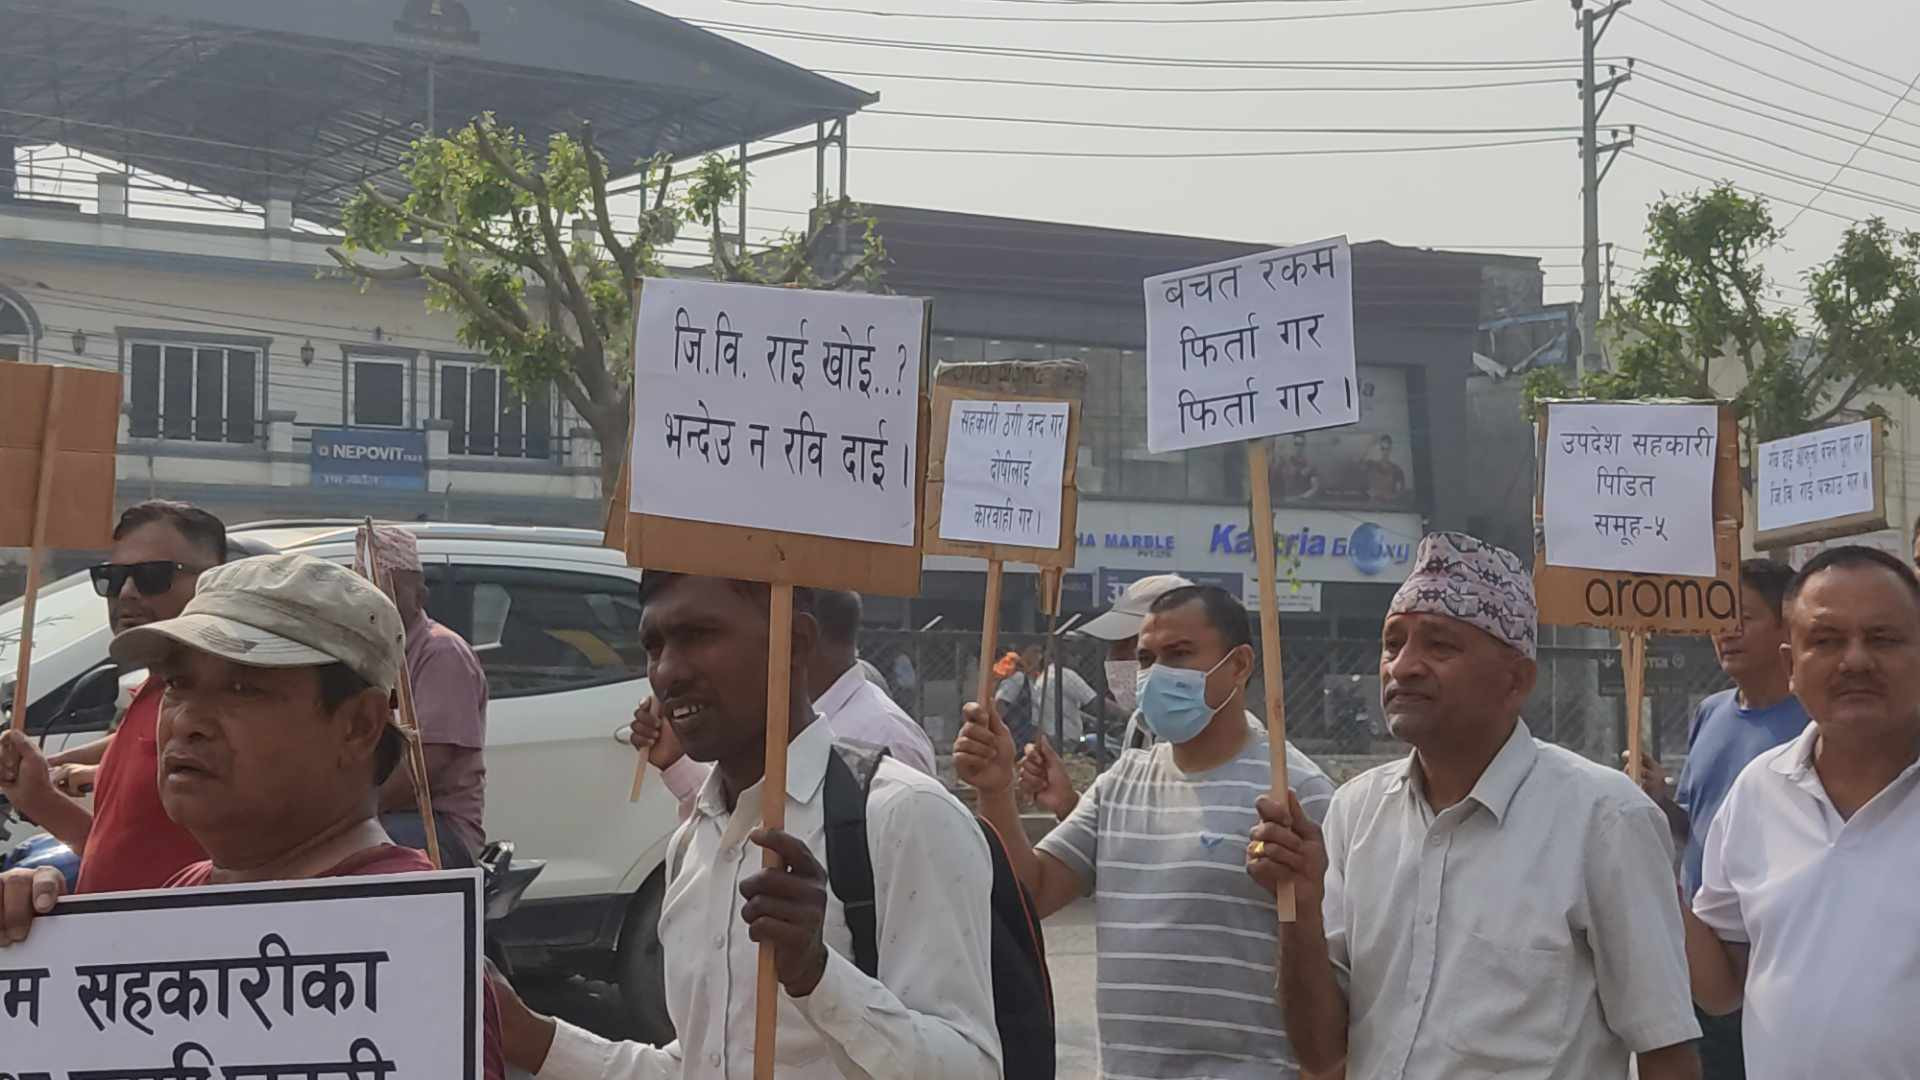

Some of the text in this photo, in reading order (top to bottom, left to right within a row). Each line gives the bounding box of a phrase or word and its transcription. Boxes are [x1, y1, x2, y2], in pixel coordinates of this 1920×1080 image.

[1161, 245, 1338, 309] बचत रकम
[766, 318, 808, 391] राई
[1180, 312, 1324, 371] फिर्ता गर
[961, 403, 1000, 437] सहकारी
[1050, 414, 1065, 438] गर
[1178, 377, 1259, 434] फिर्ता
[1276, 380, 1324, 416] गर
[333, 444, 404, 460] NEPOVIT
[665, 400, 736, 465] भन्देउ
[748, 424, 769, 470] न
[783, 411, 827, 478] रवि
[841, 419, 888, 491] दाई
[1560, 426, 1715, 457] उपदेश सहकारी
[1596, 466, 1656, 497] पिडित
[1019, 509, 1034, 533] गर
[1104, 533, 1175, 550] MARBLE
[1585, 578, 1737, 619] aroma
[74, 932, 391, 1036] सहकारीका
